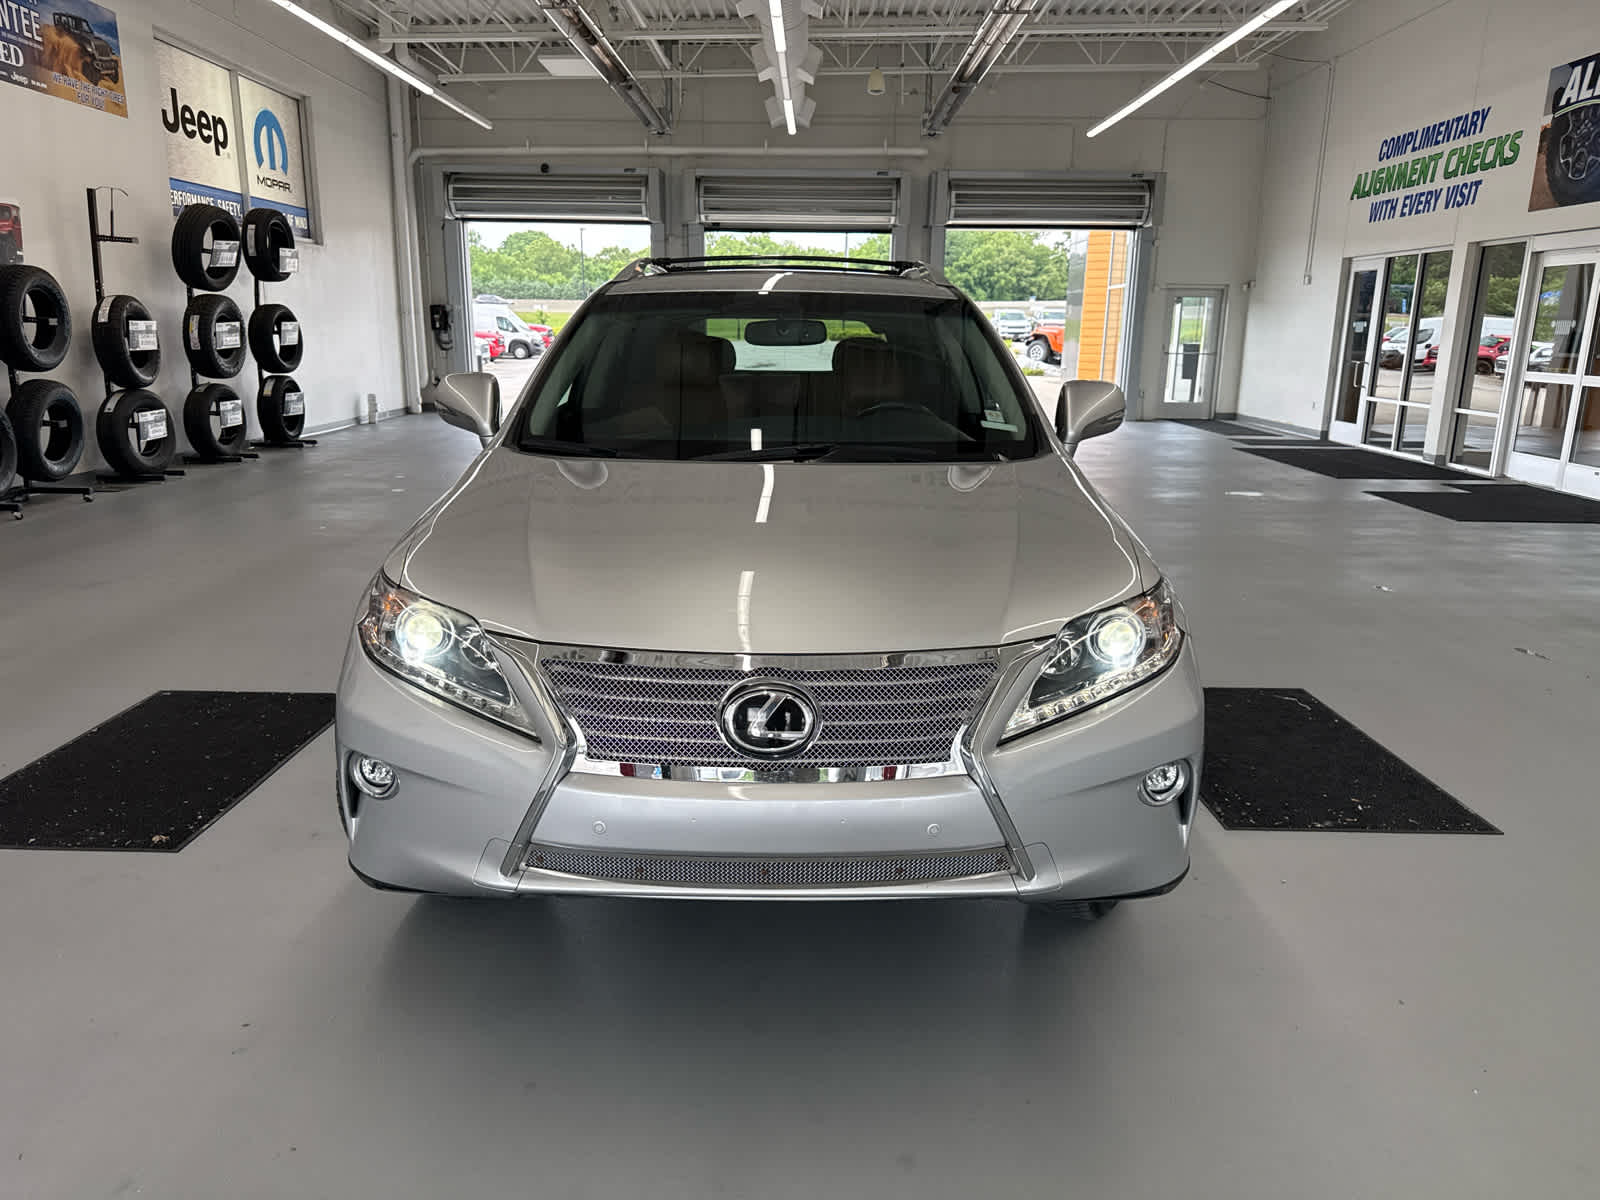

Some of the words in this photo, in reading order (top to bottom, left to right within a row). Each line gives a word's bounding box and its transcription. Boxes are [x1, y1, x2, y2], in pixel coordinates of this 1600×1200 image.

[1559, 60, 1600, 107] AL
[161, 87, 229, 156] Jeep
[1378, 106, 1492, 162] COMPLIMENTARY
[256, 174, 292, 193] MOPAR
[1350, 151, 1444, 200] ALIGNMENT
[1443, 130, 1523, 180] CHECKS
[1368, 197, 1399, 223] WITH
[1400, 188, 1442, 218] EVERY
[1444, 179, 1483, 210] VISIT
